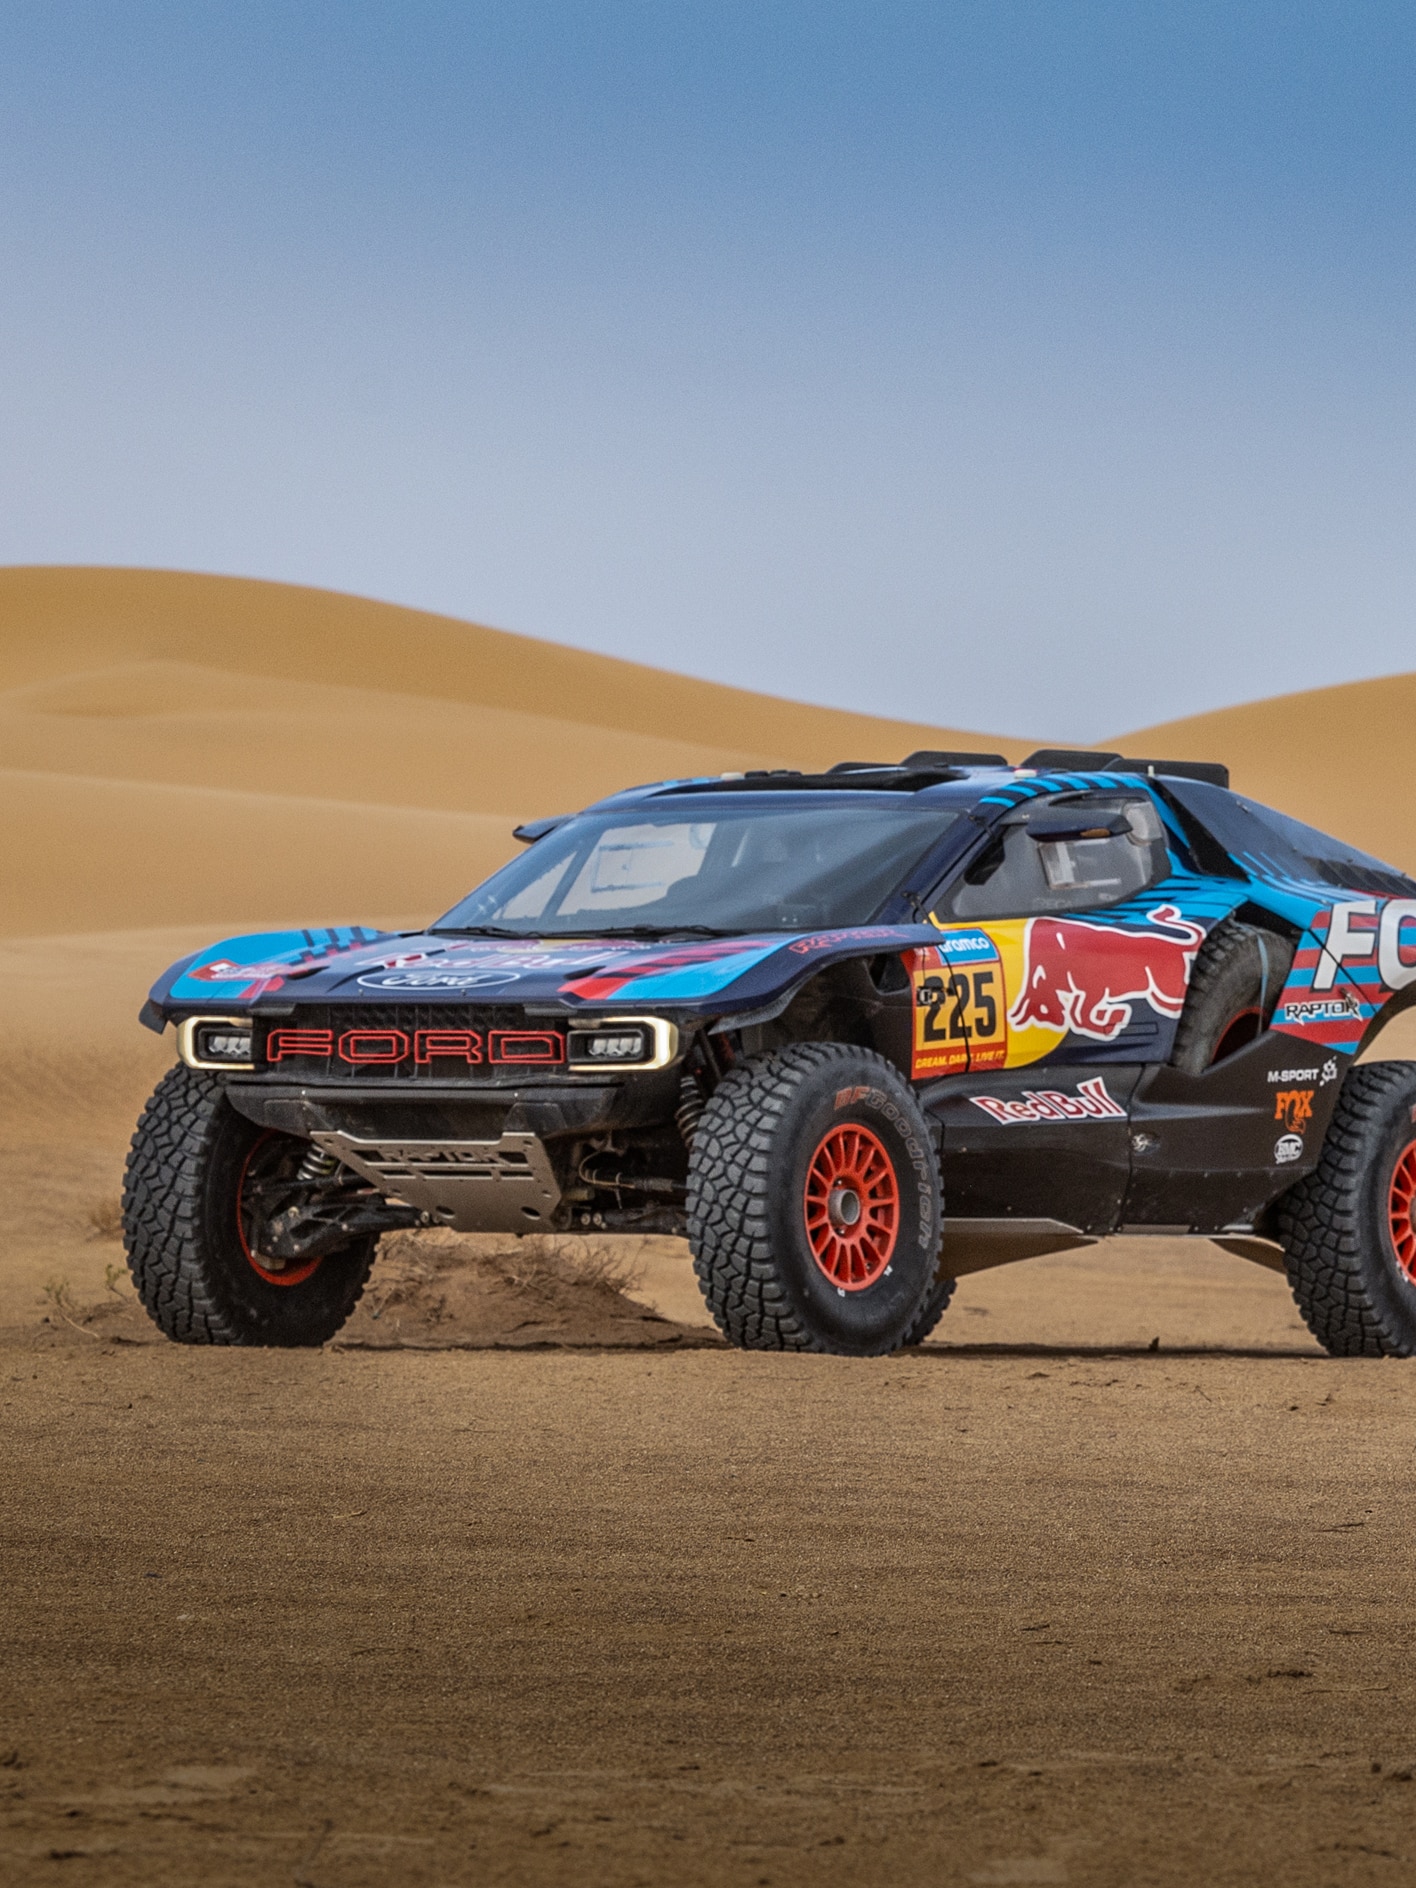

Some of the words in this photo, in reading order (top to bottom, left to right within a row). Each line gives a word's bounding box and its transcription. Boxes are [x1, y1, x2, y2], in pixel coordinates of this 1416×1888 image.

[923, 970, 998, 1043] 225
[1284, 997, 1364, 1025] RAPTOR
[266, 1028, 565, 1064] FORD
[1267, 1068, 1319, 1083] M-SPORT
[1274, 1089, 1315, 1121] FOX
